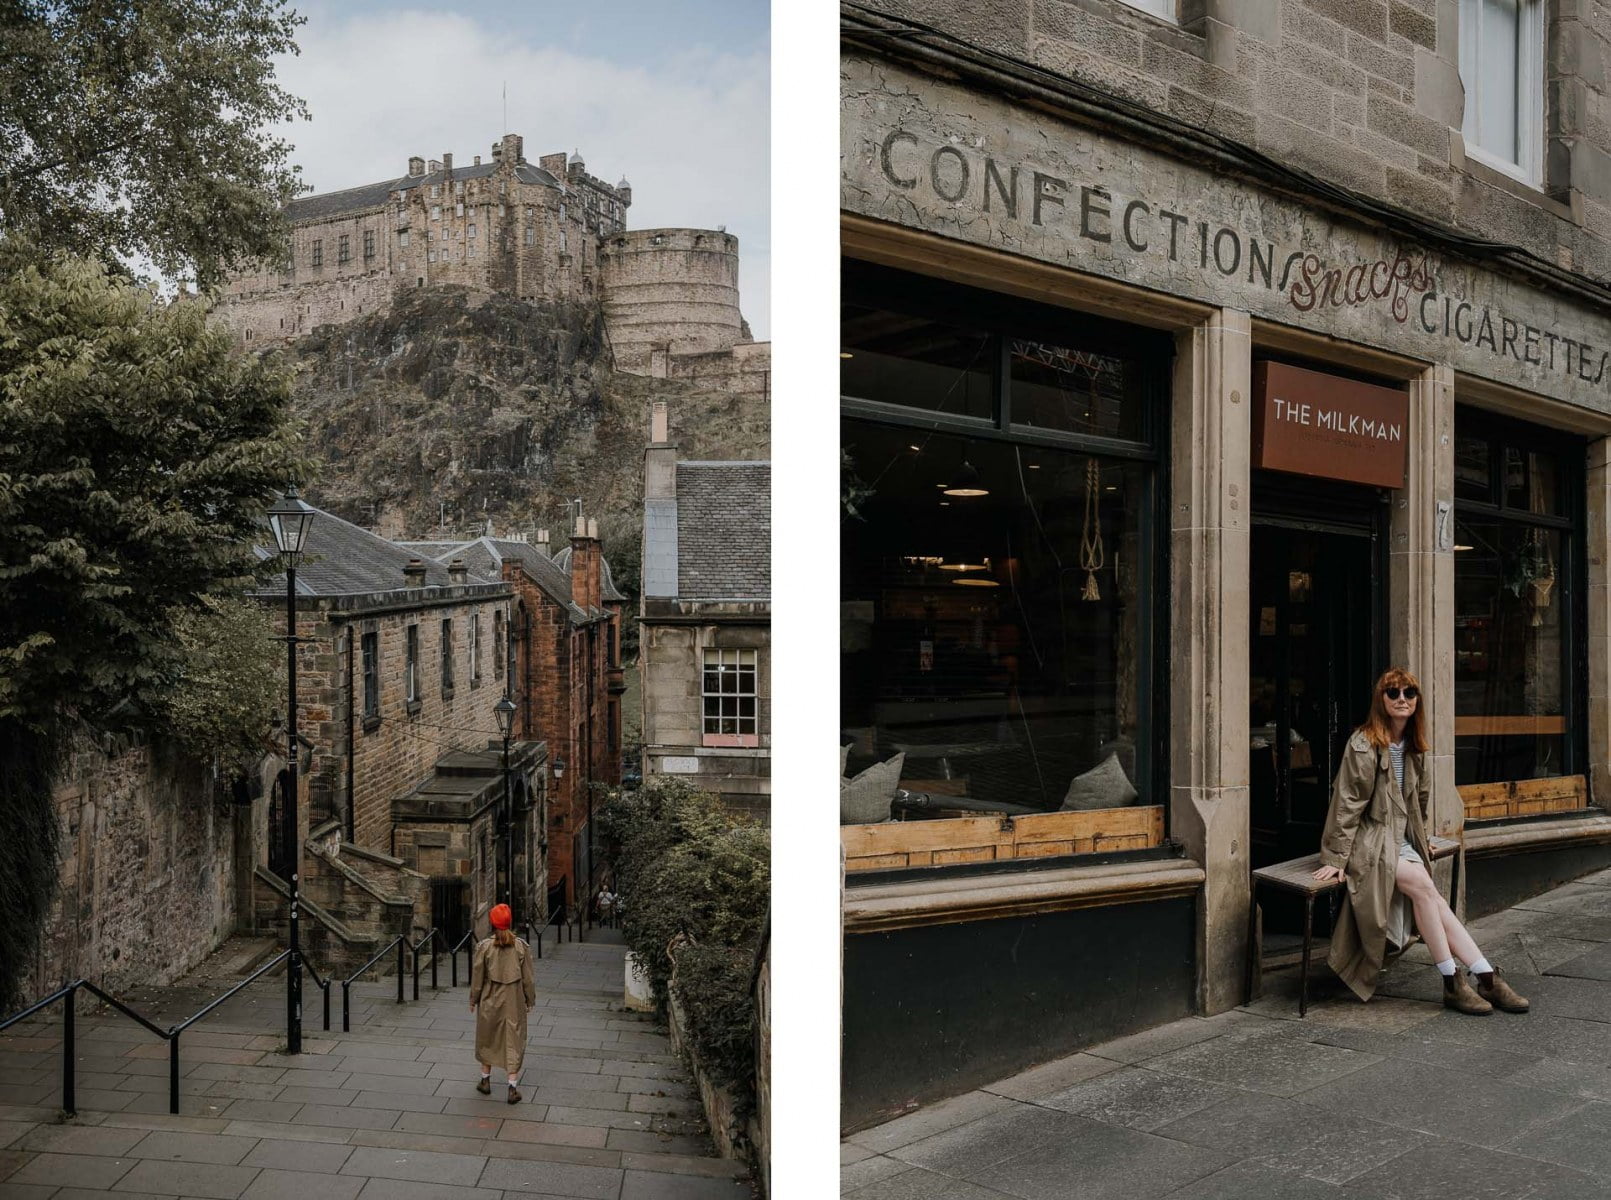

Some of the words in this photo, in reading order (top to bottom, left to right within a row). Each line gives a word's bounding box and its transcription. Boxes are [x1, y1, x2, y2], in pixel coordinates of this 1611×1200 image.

[880, 129, 1304, 291] CONFECTIONS
[1289, 248, 1435, 324] Snacks
[1419, 292, 1609, 384] CIGARETTES
[1273, 398, 1311, 426] THE
[1317, 409, 1401, 441] MILKMAN
